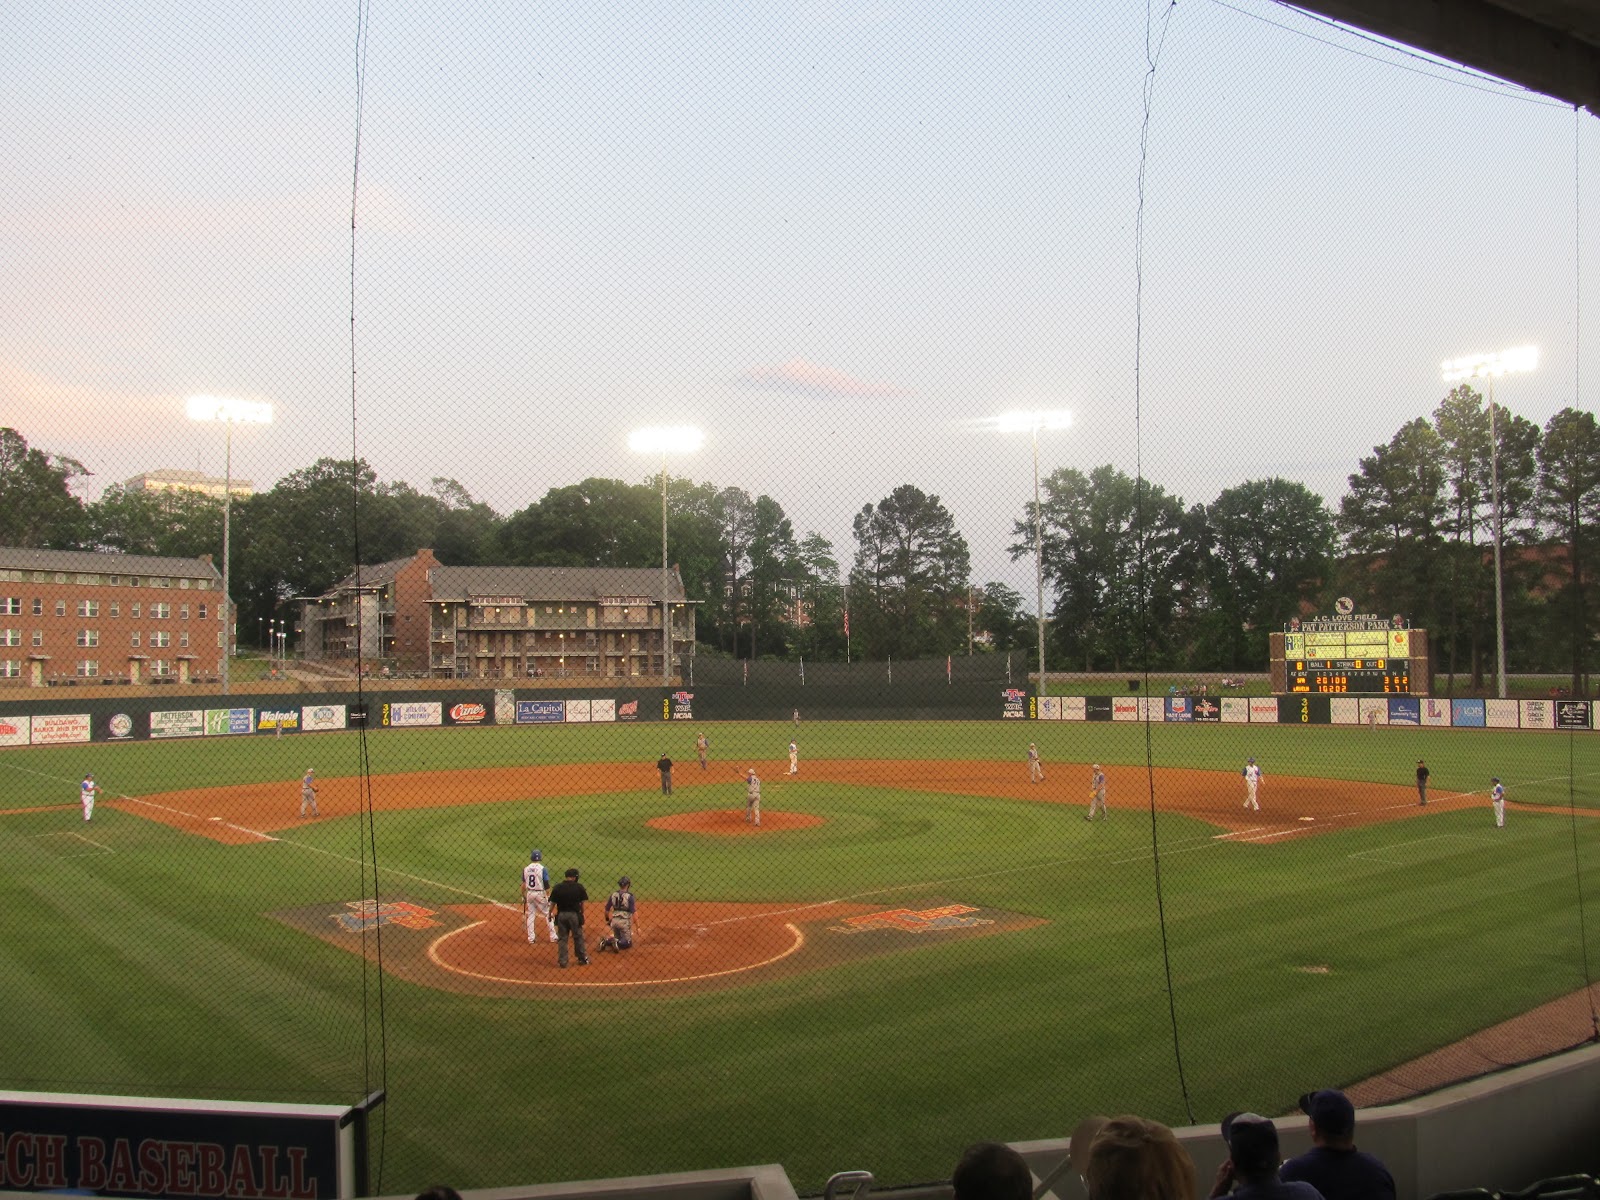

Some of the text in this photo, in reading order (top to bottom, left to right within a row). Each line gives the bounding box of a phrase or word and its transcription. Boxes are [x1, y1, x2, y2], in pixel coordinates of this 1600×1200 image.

[1302, 621, 1390, 631] PAT PATTERSON PARK
[1297, 662, 1303, 670] 8
[451, 704, 486, 720] Cane's
[519, 704, 529, 712] La
[532, 704, 562, 714] Capitol
[529, 875, 535, 888] 8
[0, 1131, 318, 1199] CH BASEBALL
